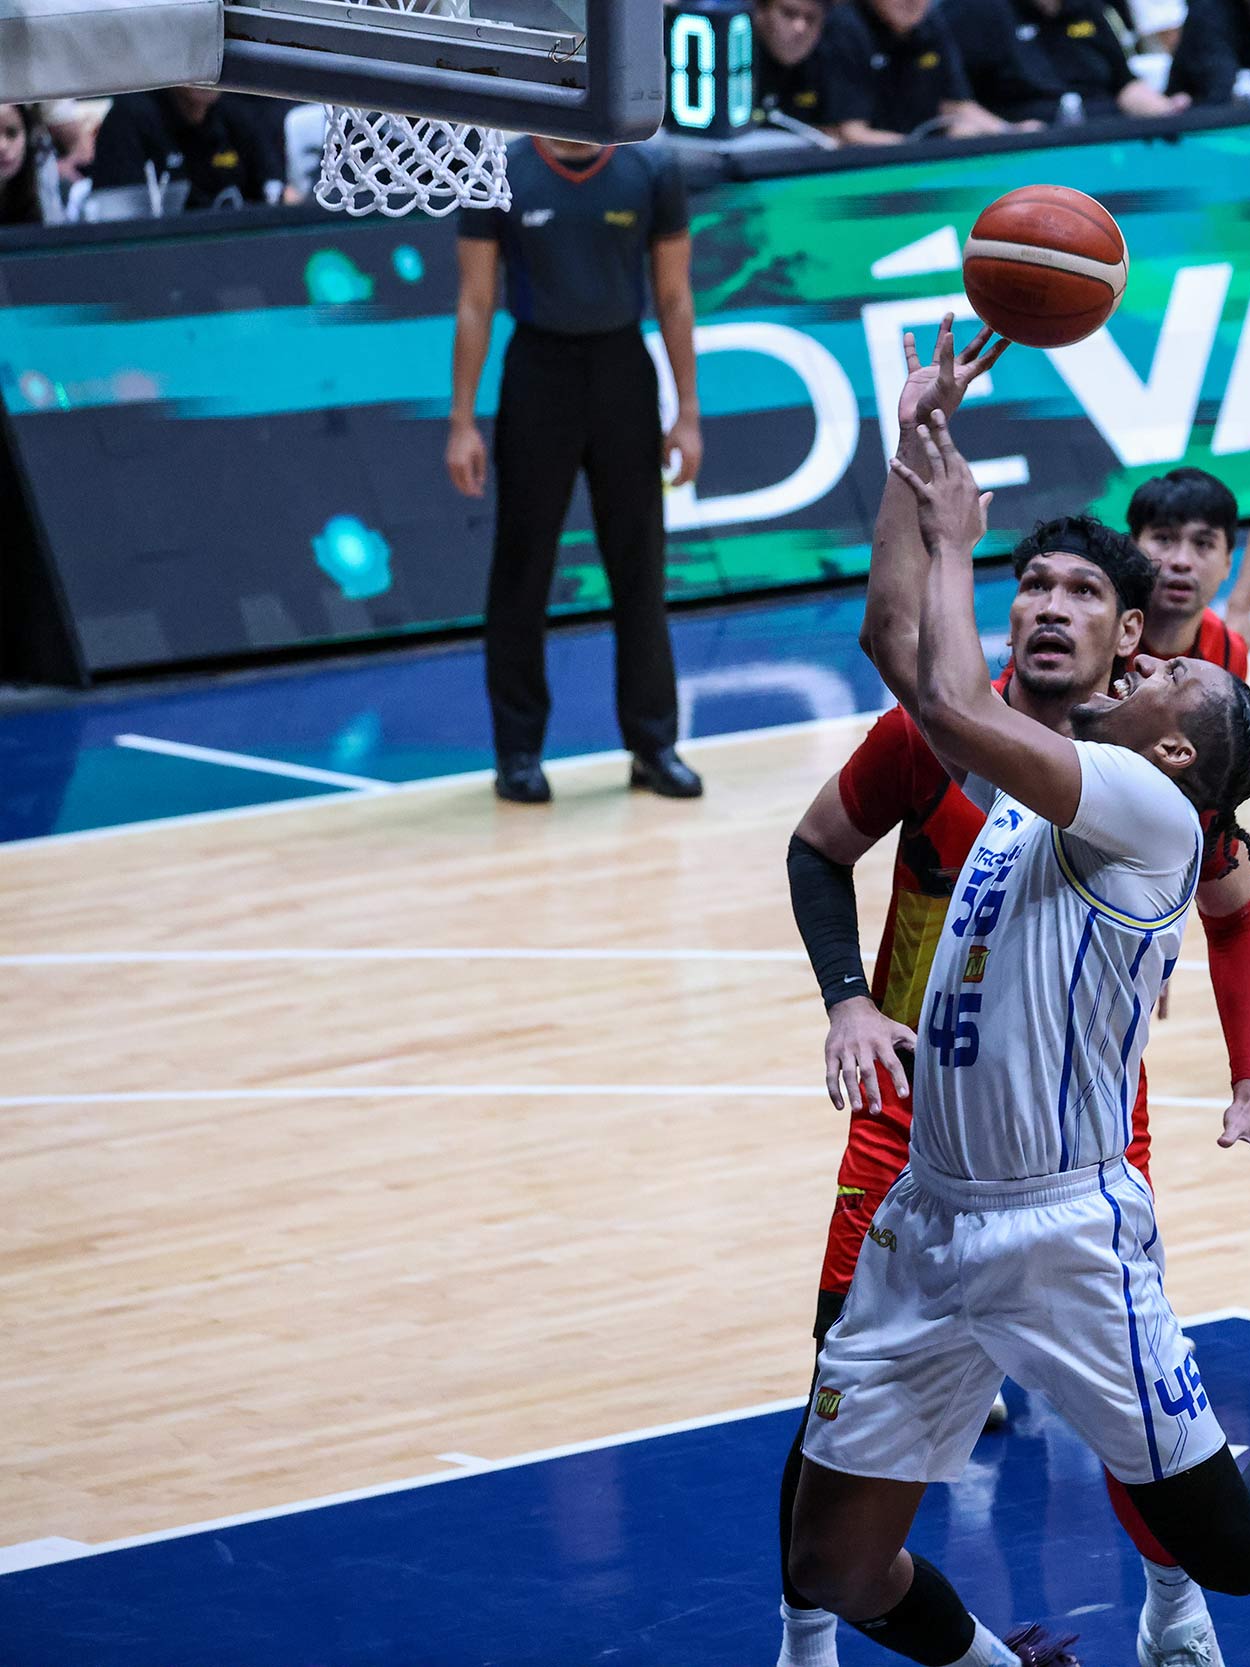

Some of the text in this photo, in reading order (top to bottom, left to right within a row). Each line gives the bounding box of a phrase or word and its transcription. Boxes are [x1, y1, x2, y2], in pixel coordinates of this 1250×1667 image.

[928, 990, 983, 1068] 45
[816, 1391, 847, 1415] TNT
[1153, 1351, 1208, 1421] 45
